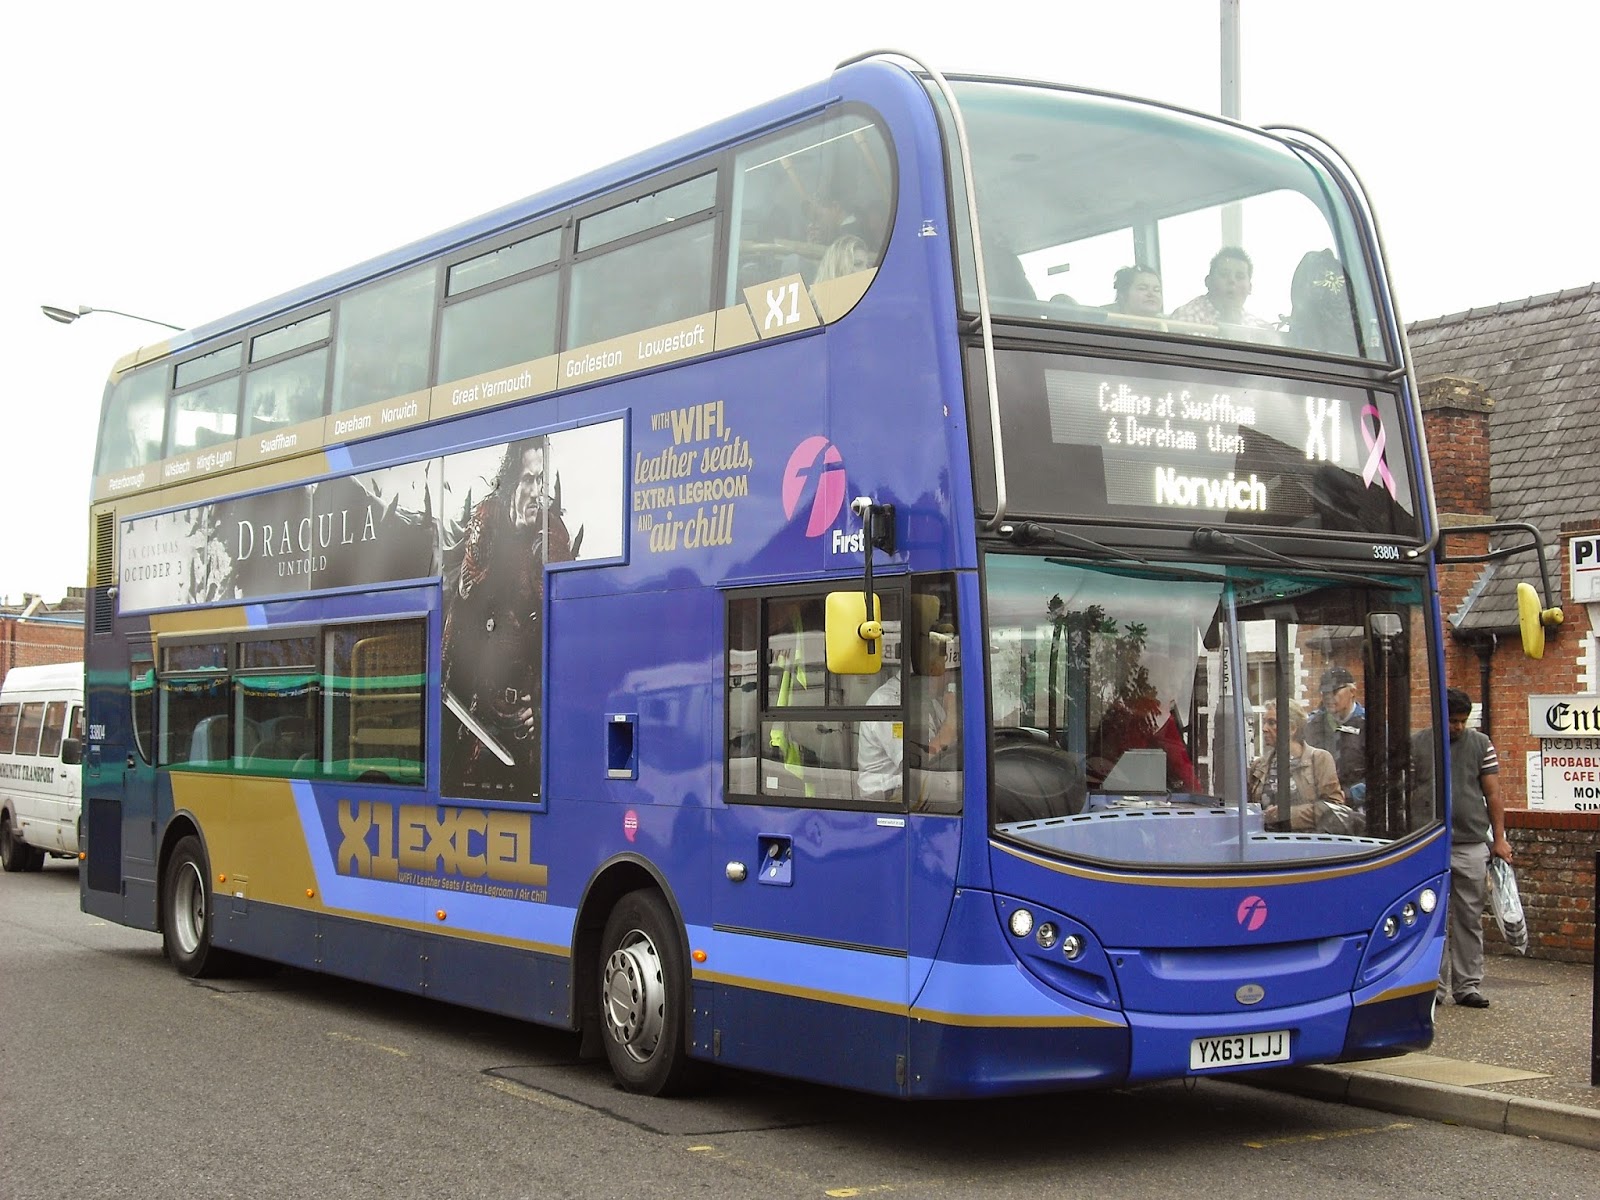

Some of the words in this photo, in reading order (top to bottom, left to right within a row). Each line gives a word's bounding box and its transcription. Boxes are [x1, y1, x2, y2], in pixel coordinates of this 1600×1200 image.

[764, 282, 800, 330] X1
[566, 350, 622, 378] Gorleston
[638, 323, 705, 360] Lowestoft
[452, 385, 478, 406] Great
[482, 370, 532, 399] Yarmouth
[1099, 381, 1151, 415] Calling
[1156, 392, 1176, 418] at
[1180, 390, 1256, 425] Swaffham
[334, 413, 371, 436] Dereham
[381, 400, 418, 424] Norwich
[651, 411, 670, 431] WITH
[1305, 395, 1341, 462] X1
[260, 432, 297, 454] Swaffham
[1126, 416, 1197, 450] Dereham
[1207, 424, 1246, 454] then
[634, 446, 698, 484] leather
[633, 486, 676, 512] EXTRA
[678, 475, 748, 505] LEGROOM
[1154, 466, 1267, 511] Norwich
[237, 505, 377, 561] DRACULA
[637, 514, 653, 532] AND
[832, 528, 865, 554] First
[1372, 545, 1400, 560] 33804
[124, 562, 171, 582] OCTOBER
[278, 555, 327, 577] UNTOLD
[1543, 757, 1600, 767] PROBABL
[1563, 771, 1595, 782] CAFE
[417, 875, 441, 887] Leather
[441, 878, 460, 890] Seats
[465, 881, 483, 893] Extra
[484, 884, 513, 898] Legroom
[519, 888, 530, 900] Air
[531, 890, 548, 903] Chill
[1199, 1038, 1244, 1063] YX63
[1250, 1034, 1283, 1059] LJJ
